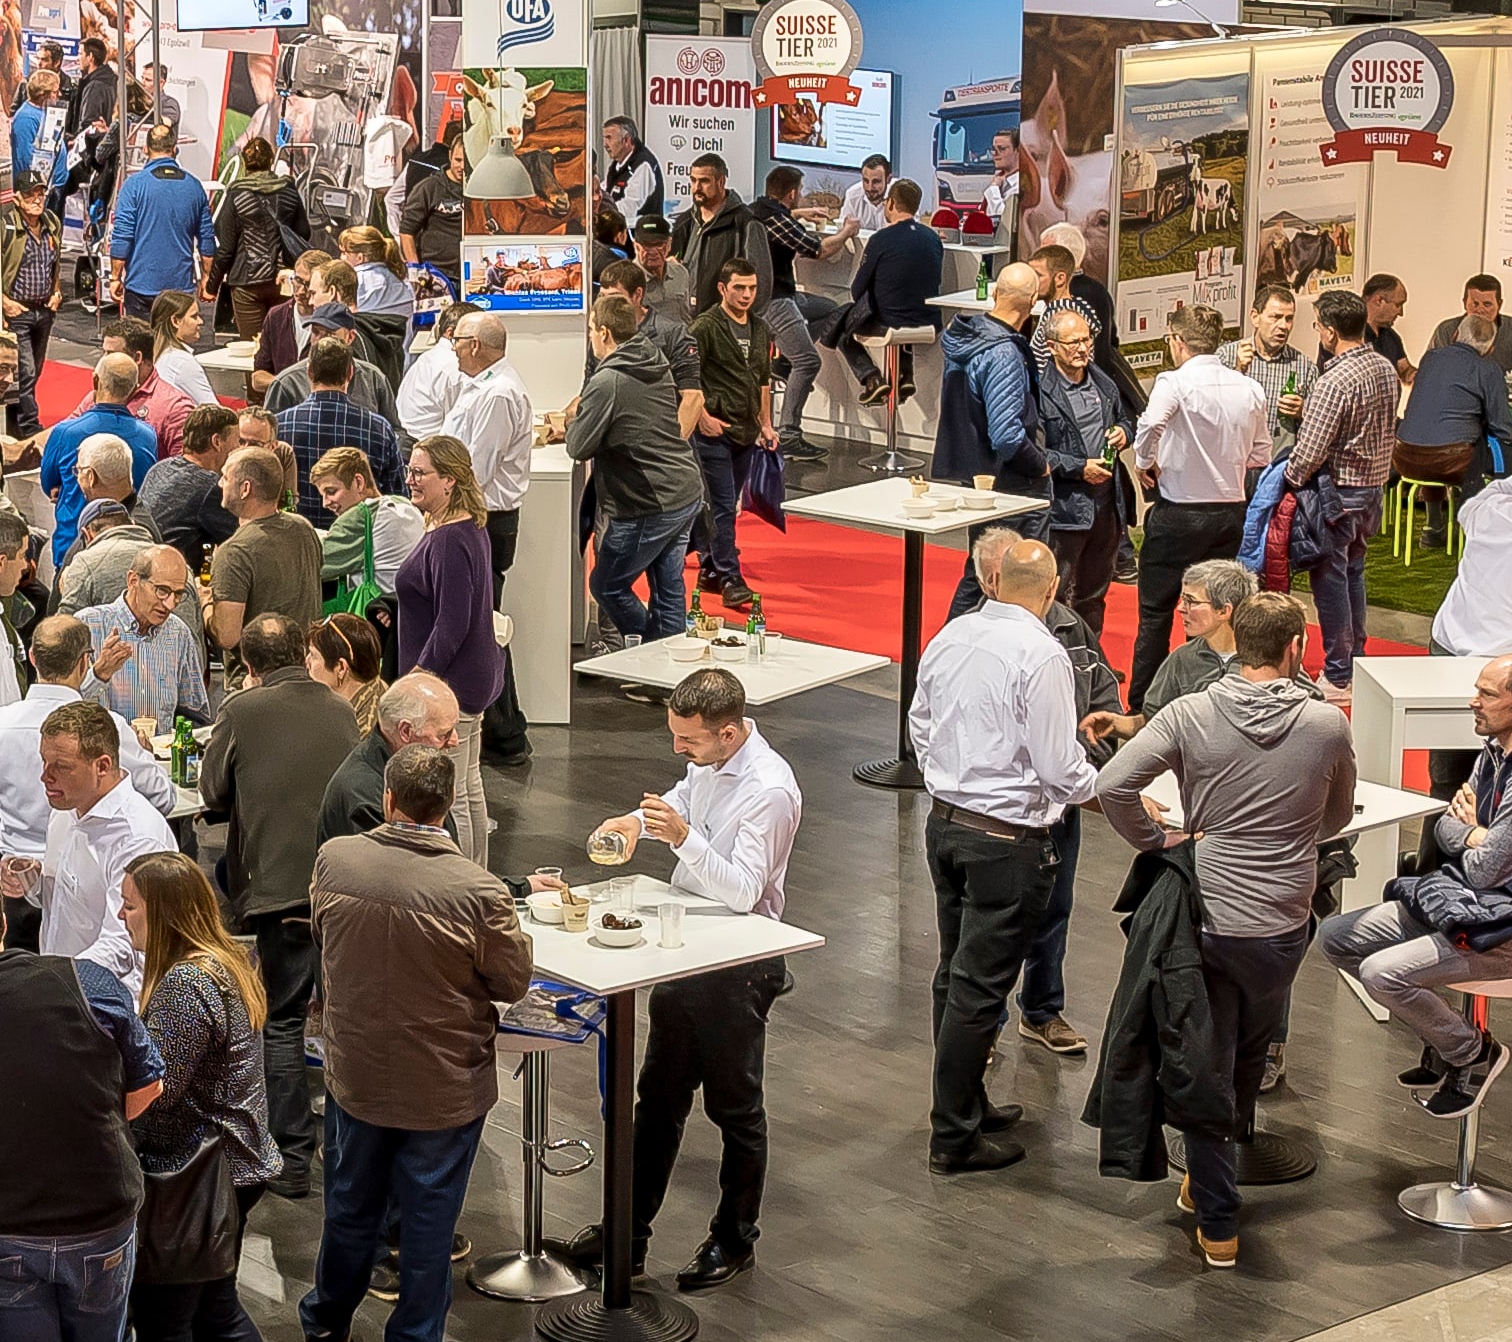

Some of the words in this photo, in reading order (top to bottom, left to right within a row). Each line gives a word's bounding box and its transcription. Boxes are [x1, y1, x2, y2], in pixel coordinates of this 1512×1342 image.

[775, 14, 837, 36] SUISSE
[776, 37, 814, 58] TIER
[817, 37, 838, 49] 2021
[1351, 59, 1425, 84] SUISSE
[649, 76, 752, 109] anicom
[787, 77, 828, 89] NEUHEIT
[1351, 85, 1396, 109] TIER
[1399, 86, 1424, 99] 2021
[669, 114, 689, 129] Wir
[692, 115, 735, 132] suchen
[693, 136, 724, 152] Dich!
[1364, 132, 1411, 145] NEUHEIT
[1319, 276, 1352, 287] NAVETA
